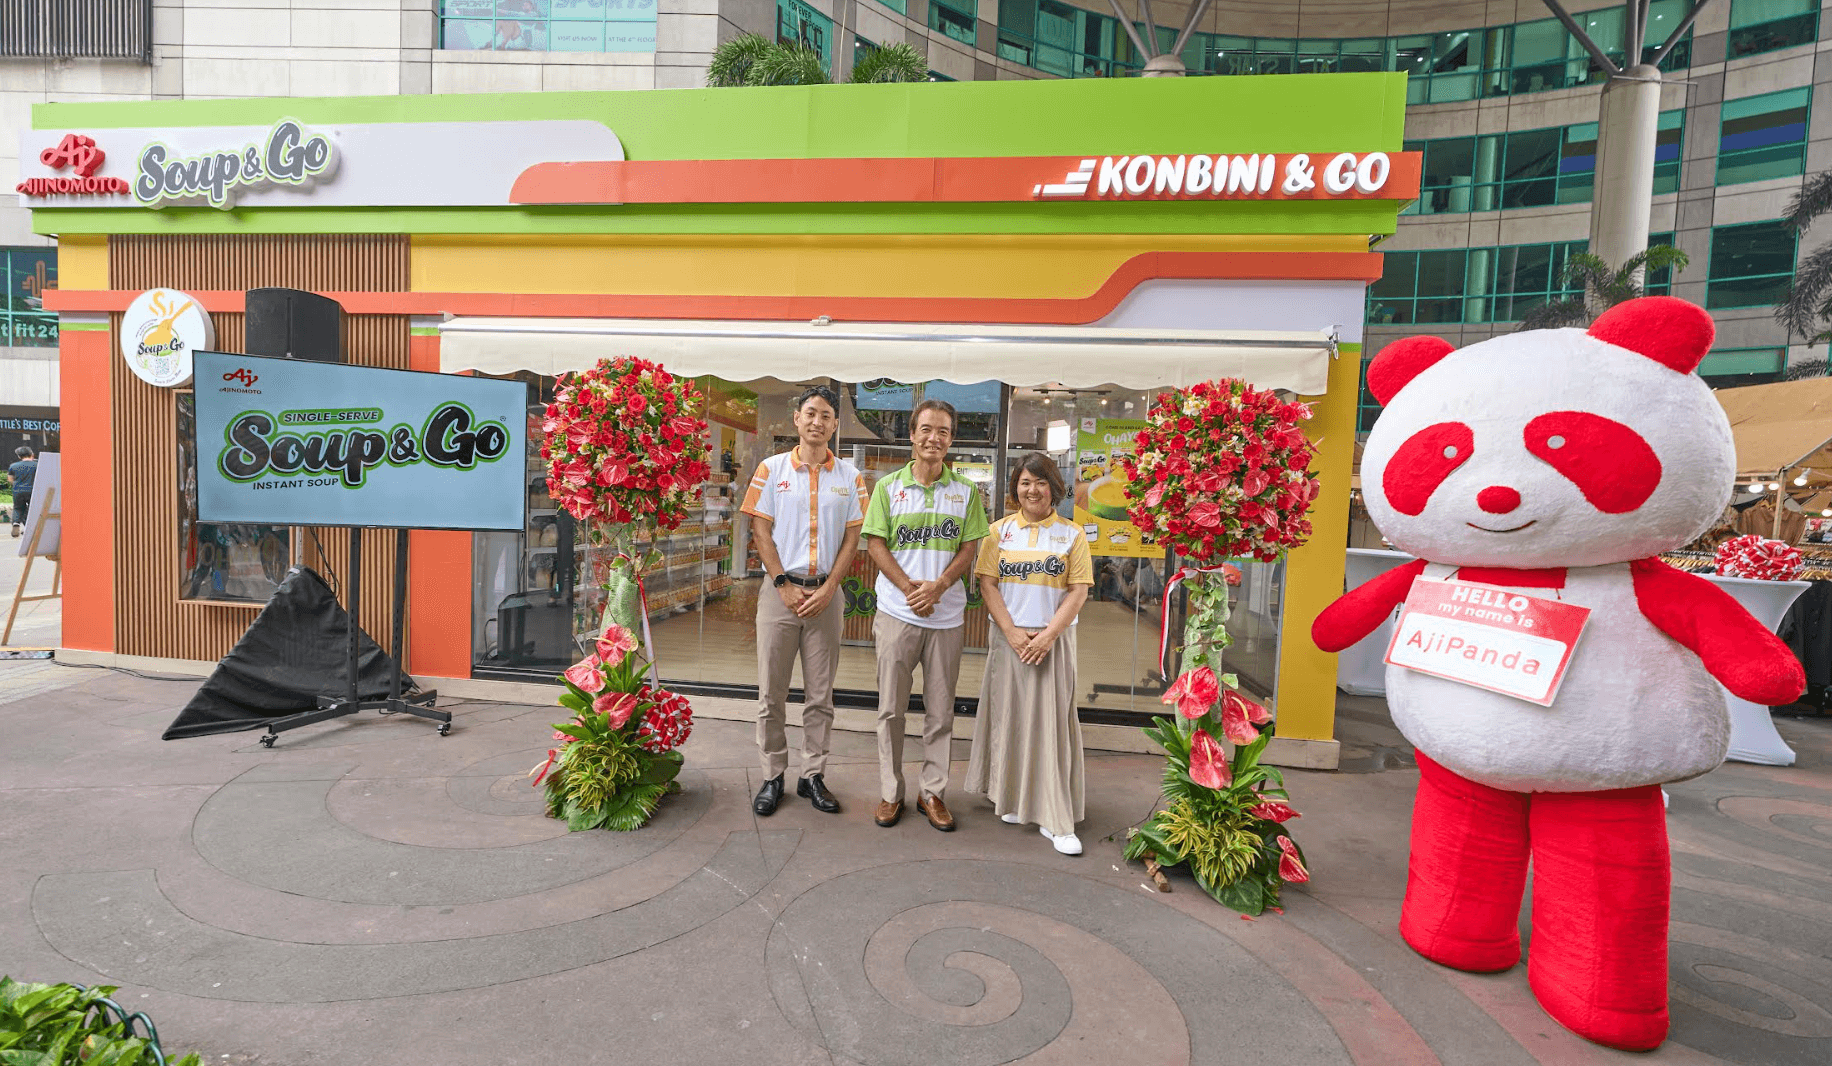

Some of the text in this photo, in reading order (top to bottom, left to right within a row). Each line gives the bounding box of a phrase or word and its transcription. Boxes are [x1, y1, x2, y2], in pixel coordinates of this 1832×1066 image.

[136, 120, 330, 203] Soup & Go
[1097, 152, 1391, 196] KONBINI & GO
[16, 177, 124, 196] AJINOMOTO
[16, 323, 36, 338] fit
[38, 325, 59, 338] 24
[137, 341, 163, 356] Soup
[169, 337, 185, 352] Go
[218, 386, 262, 395] AJINOMOTO
[23, 419, 42, 430] BEST
[284, 410, 379, 423] SINGLE-SERVE
[221, 404, 508, 486] Soup & Go
[252, 477, 339, 491] INSTANT SOUP
[897, 524, 934, 546] Soup
[940, 517, 961, 540] Go
[999, 554, 1066, 580] Soup & Go
[1451, 586, 1529, 612] HELLO
[1438, 602, 1535, 628] my name is
[1406, 629, 1542, 676] AjiPanda
